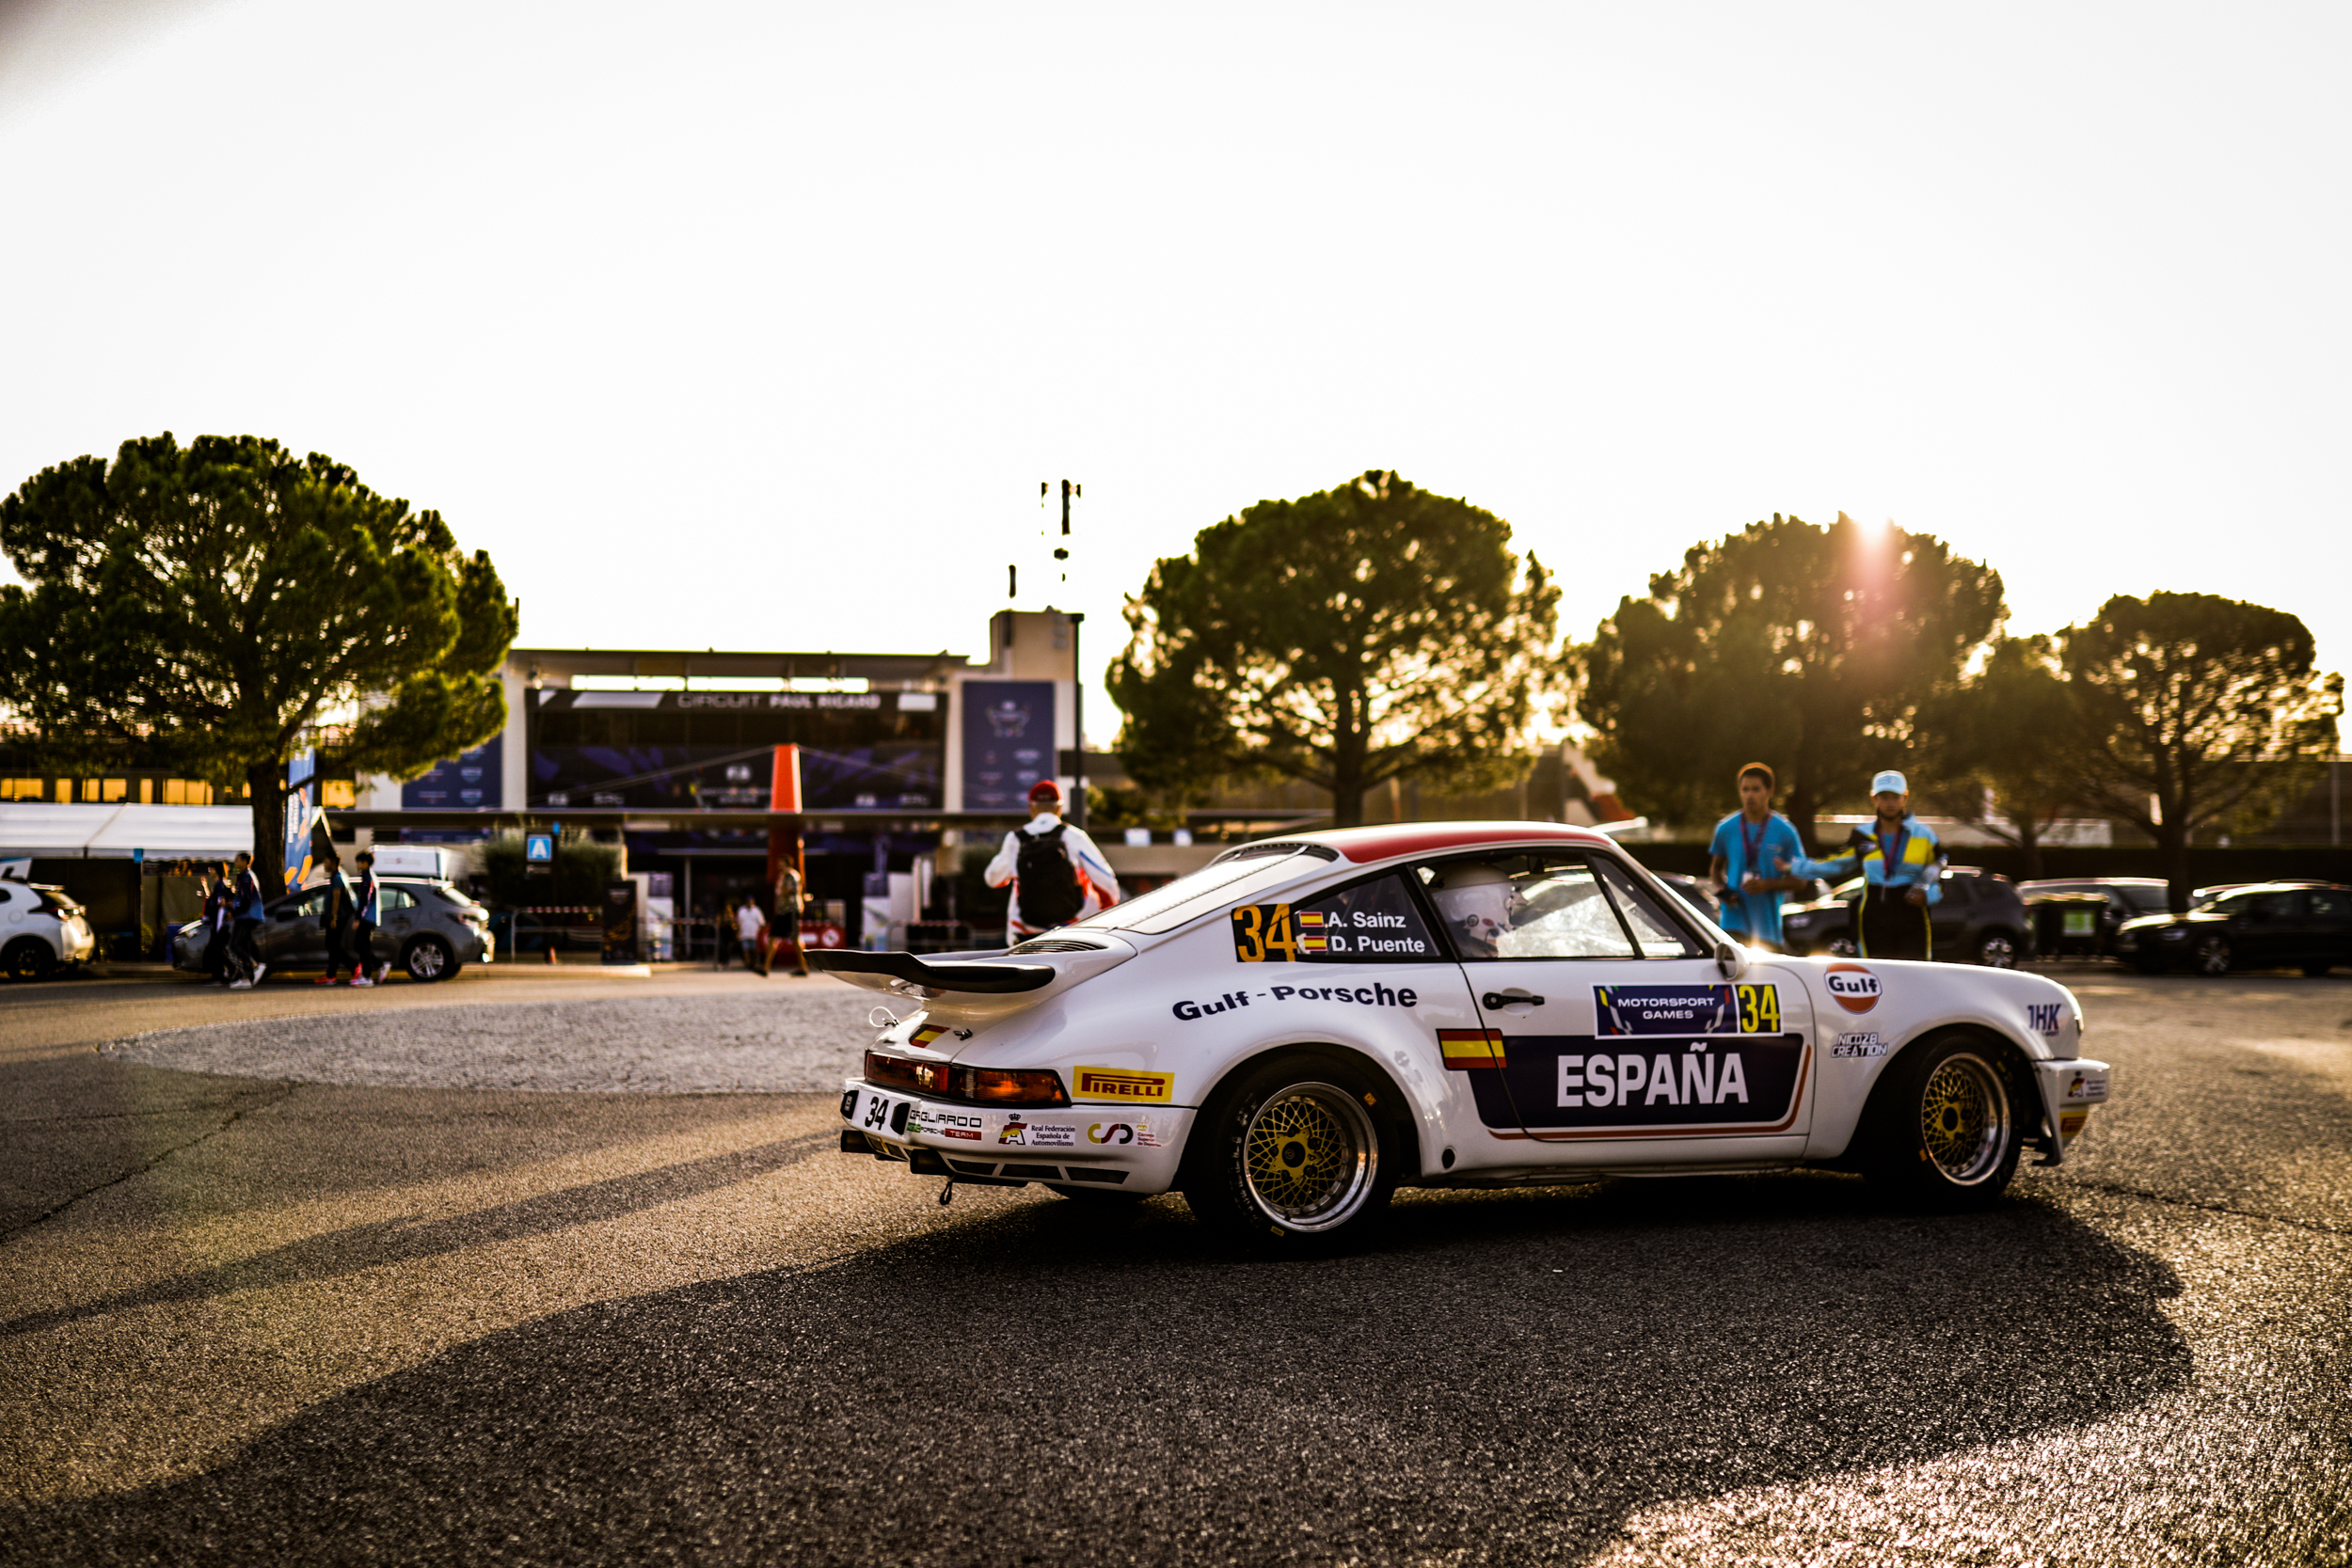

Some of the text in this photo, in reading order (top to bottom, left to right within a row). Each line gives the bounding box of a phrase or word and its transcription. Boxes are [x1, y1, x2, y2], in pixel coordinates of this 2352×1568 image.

[677, 693, 882, 709] CIRCUIT PAUL RICARD
[532, 838, 548, 859] A
[1328, 911, 1406, 928] A. Sainz
[1233, 904, 1297, 962] 34
[1331, 936, 1426, 953] D. Puente
[1828, 975, 1878, 993] Gulf
[1172, 991, 1250, 1021] Gulf
[1270, 982, 1418, 1007] Porsche
[1617, 998, 1715, 1007] MOTORSPORT
[1738, 985, 1780, 1033] 34
[1643, 1010, 1694, 1020] GAMES
[1831, 1044, 1887, 1057] CREATION
[1557, 1041, 1749, 1107] ESPAÑA
[1081, 1072, 1166, 1097] PIRELLI
[864, 1096, 890, 1131] 34
[909, 1110, 982, 1128] GAGLIARDO
[949, 1130, 974, 1138] TEAM
[1036, 1132, 1061, 1140] Española
